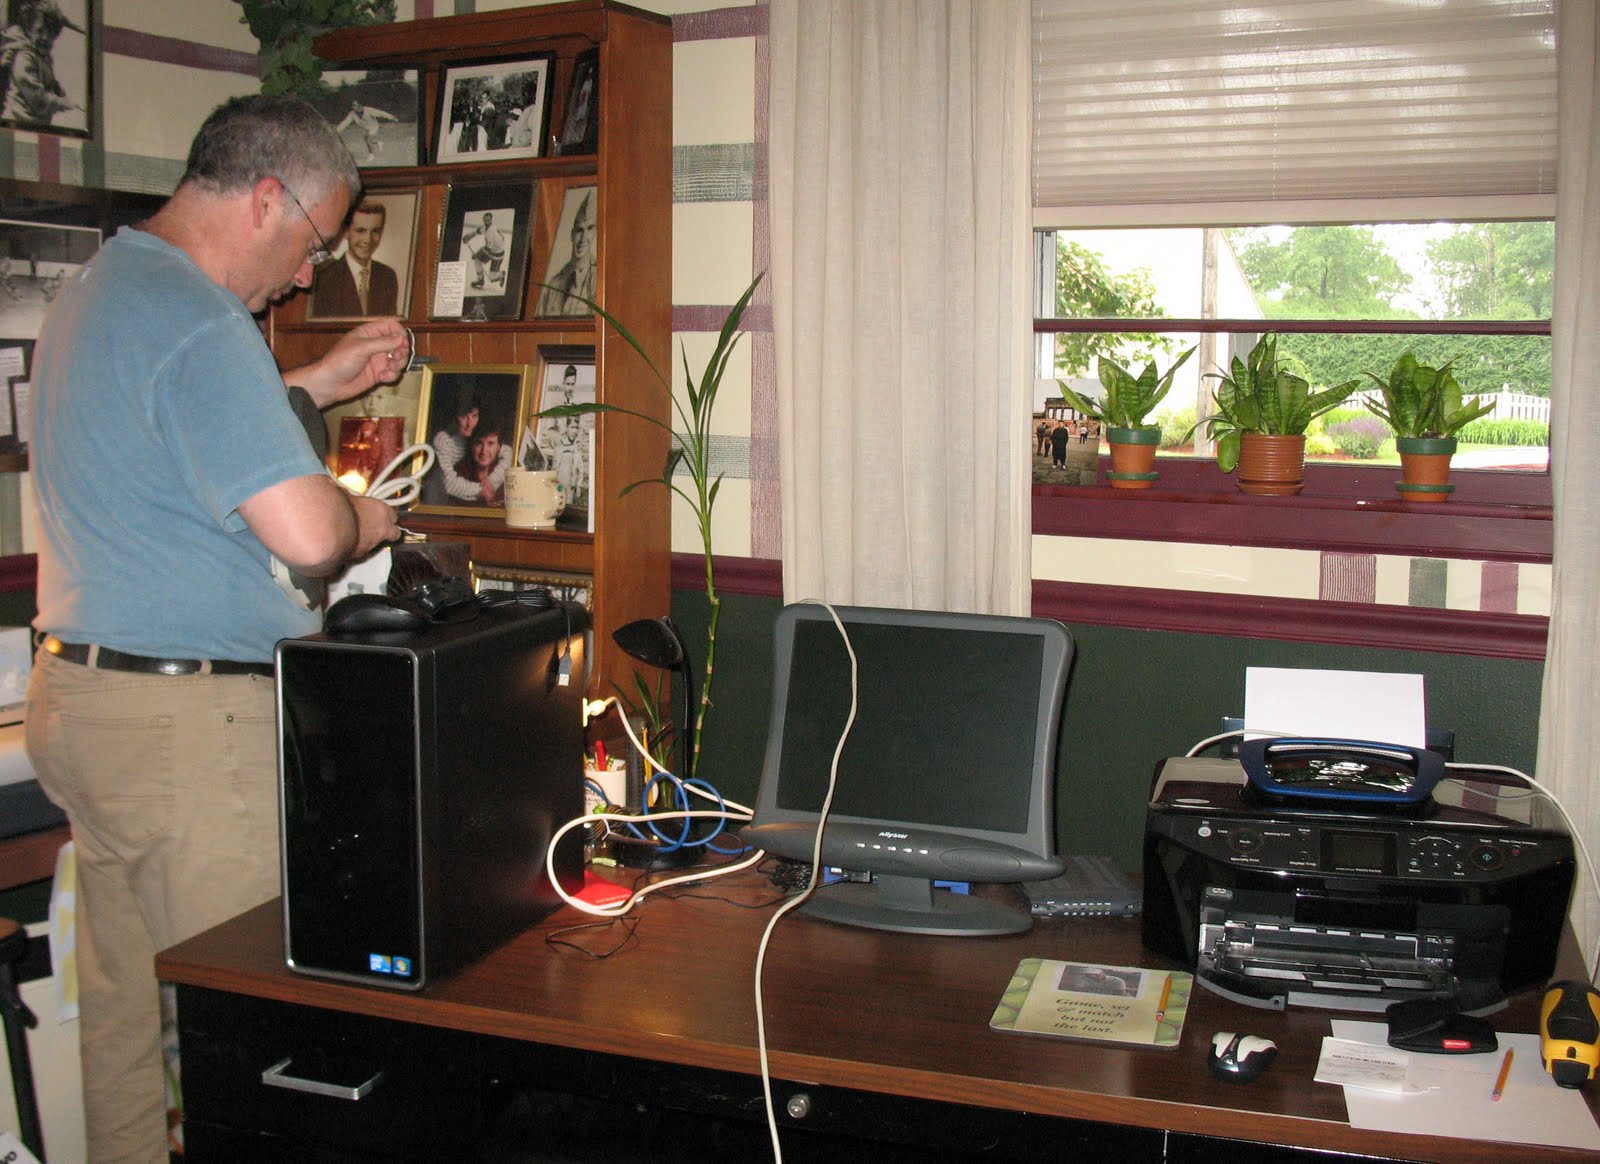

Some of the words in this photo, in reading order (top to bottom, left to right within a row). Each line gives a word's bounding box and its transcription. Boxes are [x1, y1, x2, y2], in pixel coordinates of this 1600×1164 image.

[1056, 998, 1104, 1009] Game,
[1060, 1014, 1086, 1022] but
[1078, 1009, 1125, 1018] match
